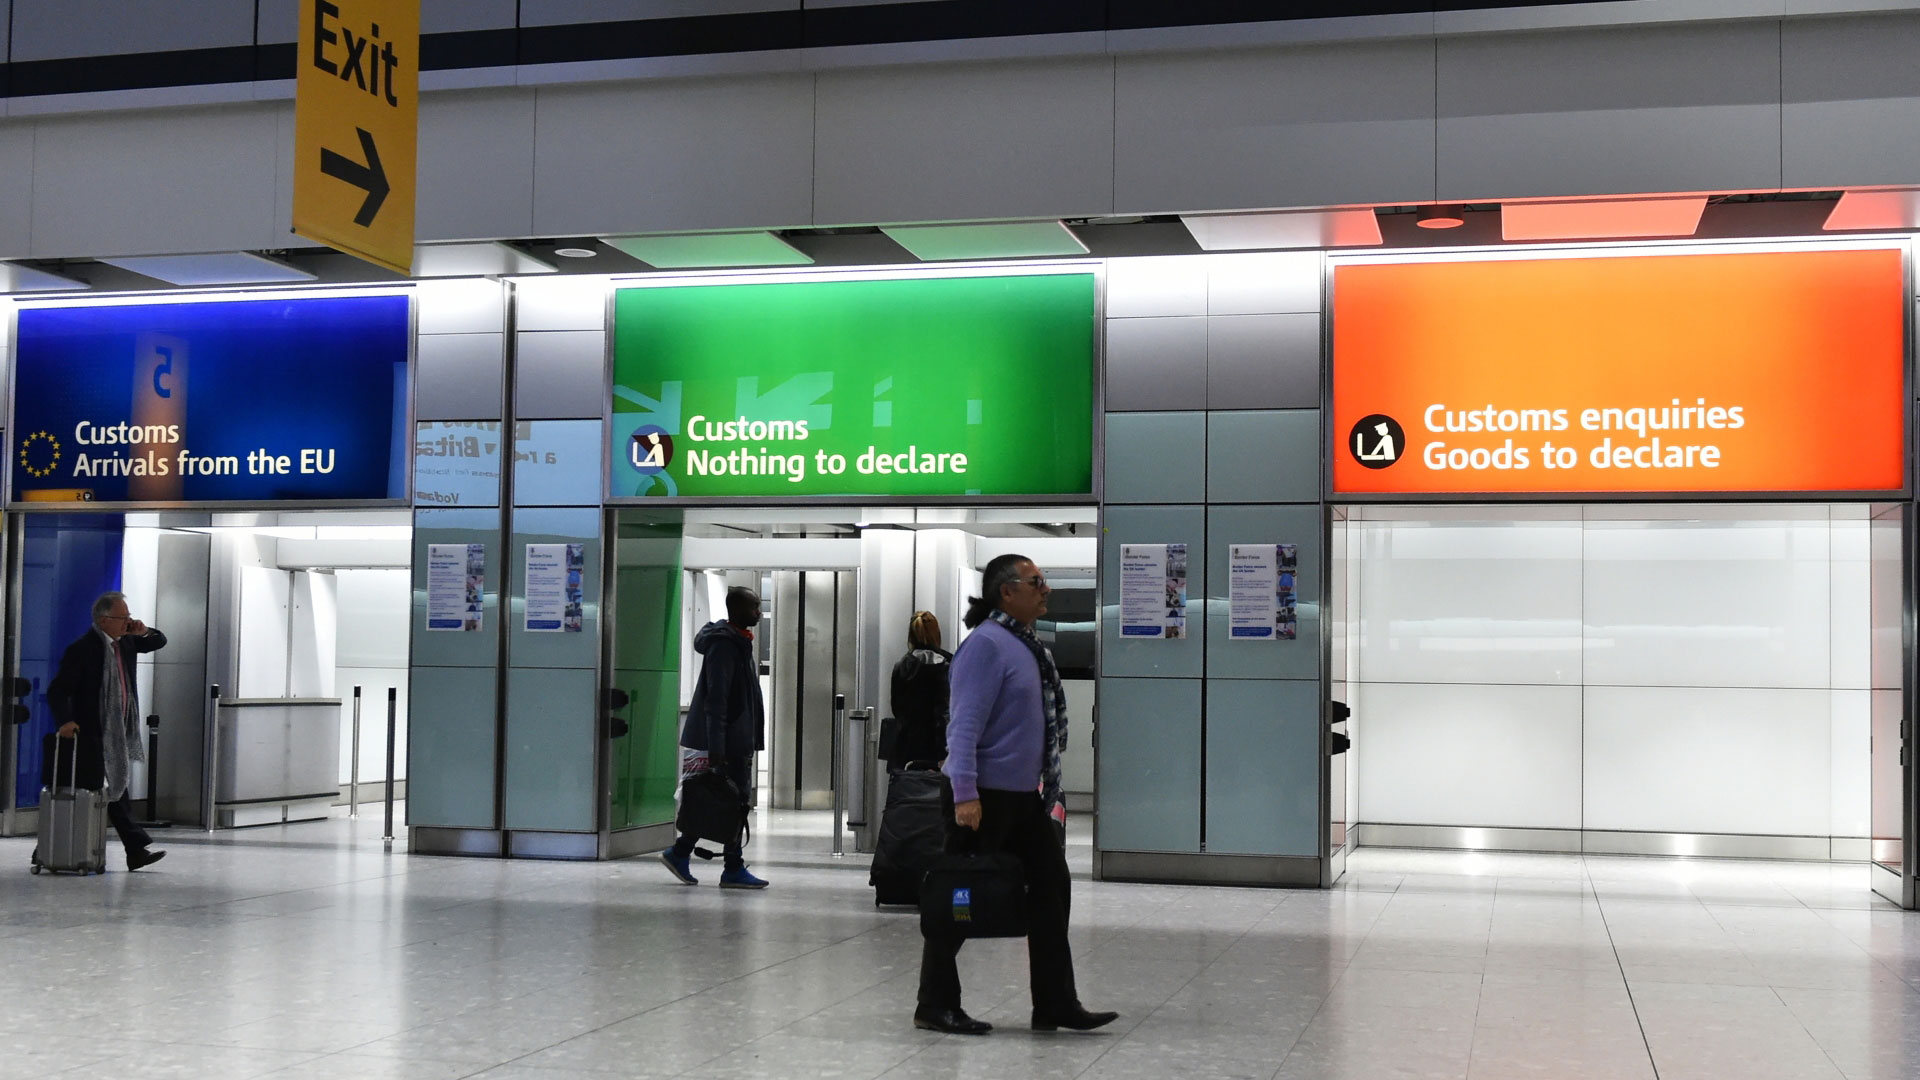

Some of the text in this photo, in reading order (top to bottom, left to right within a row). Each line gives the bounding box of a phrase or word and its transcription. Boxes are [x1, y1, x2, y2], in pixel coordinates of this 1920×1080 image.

[314, 0, 398, 108] Exit
[75, 420, 180, 445] Customs
[687, 415, 809, 442] Customs
[1423, 398, 1745, 438] Customs enquiries
[73, 448, 335, 477] Arrivals from the EU
[686, 445, 968, 482] Nothing to declare
[1423, 437, 1721, 471] Goods to declare
